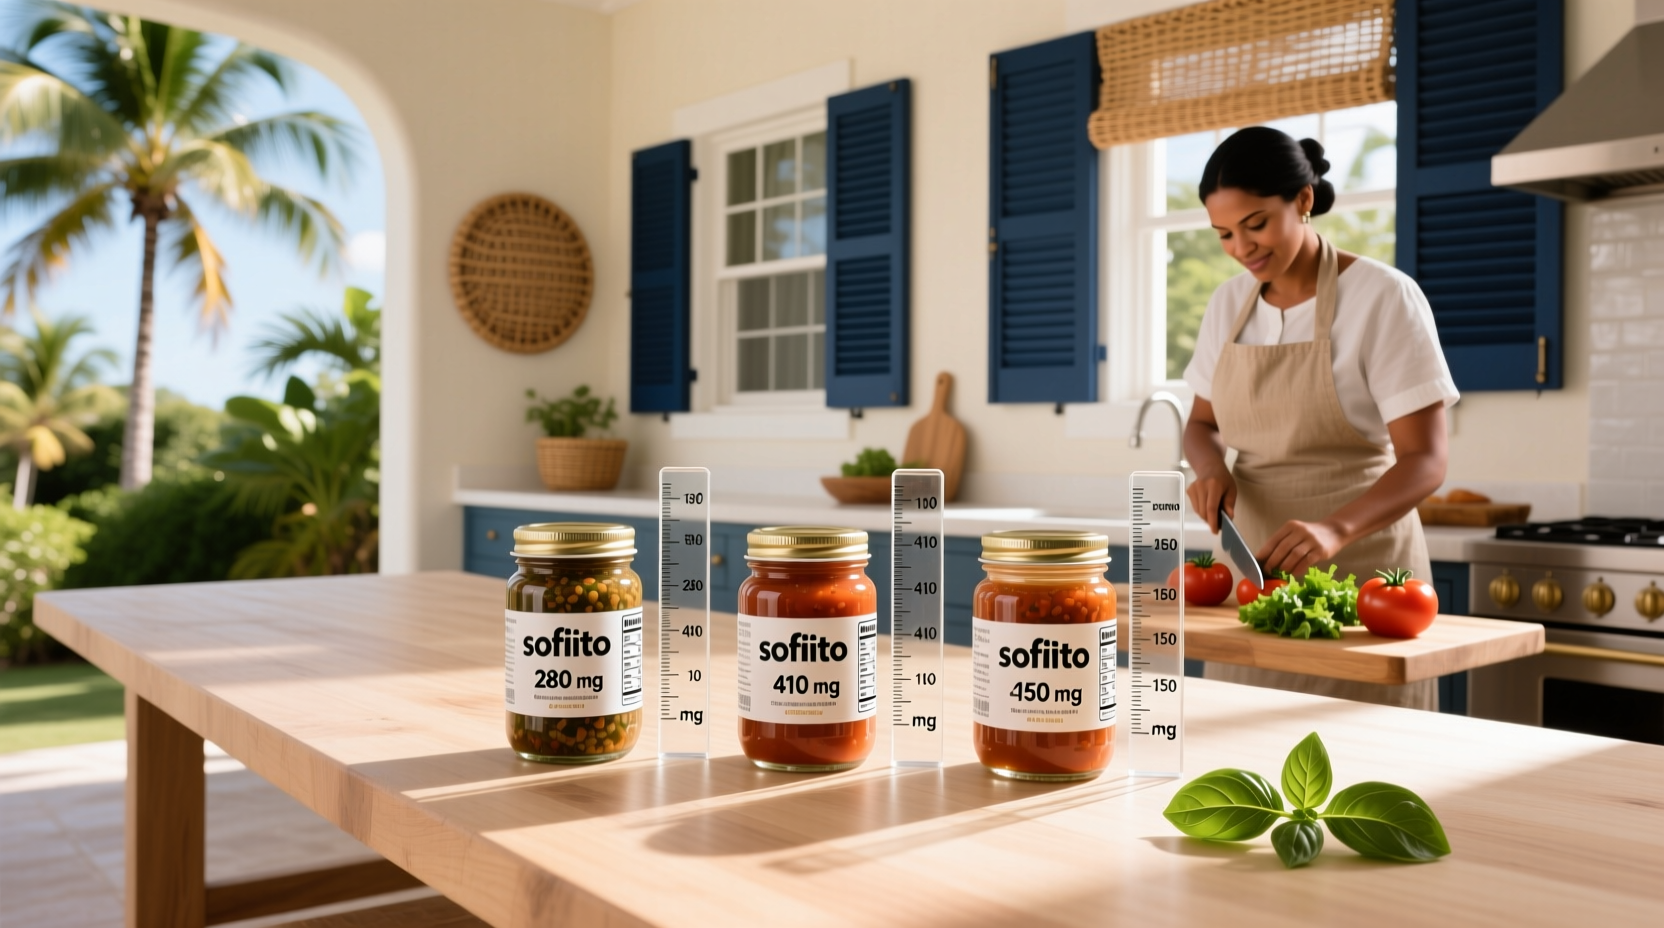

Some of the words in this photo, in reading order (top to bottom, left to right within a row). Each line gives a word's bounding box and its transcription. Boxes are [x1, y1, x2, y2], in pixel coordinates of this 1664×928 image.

[914, 536, 937, 549] 410
[914, 582, 937, 595] 410
[682, 625, 703, 638] 410
[914, 626, 937, 640] 410
[1153, 632, 1177, 646] 150
[523, 626, 611, 657] sofiito
[759, 632, 848, 662] sofiito
[998, 637, 1090, 669] sofiito
[534, 669, 572, 689] 280
[576, 675, 603, 692] mg
[688, 669, 702, 682] 10
[915, 672, 936, 685] 110
[773, 675, 809, 694] 410
[813, 681, 840, 698] mg
[1153, 678, 1177, 692] 150
[1009, 681, 1050, 702] 450
[1054, 688, 1082, 706] mg
[680, 710, 703, 725] mg
[912, 716, 936, 731] mg
[1152, 725, 1177, 740] mg
